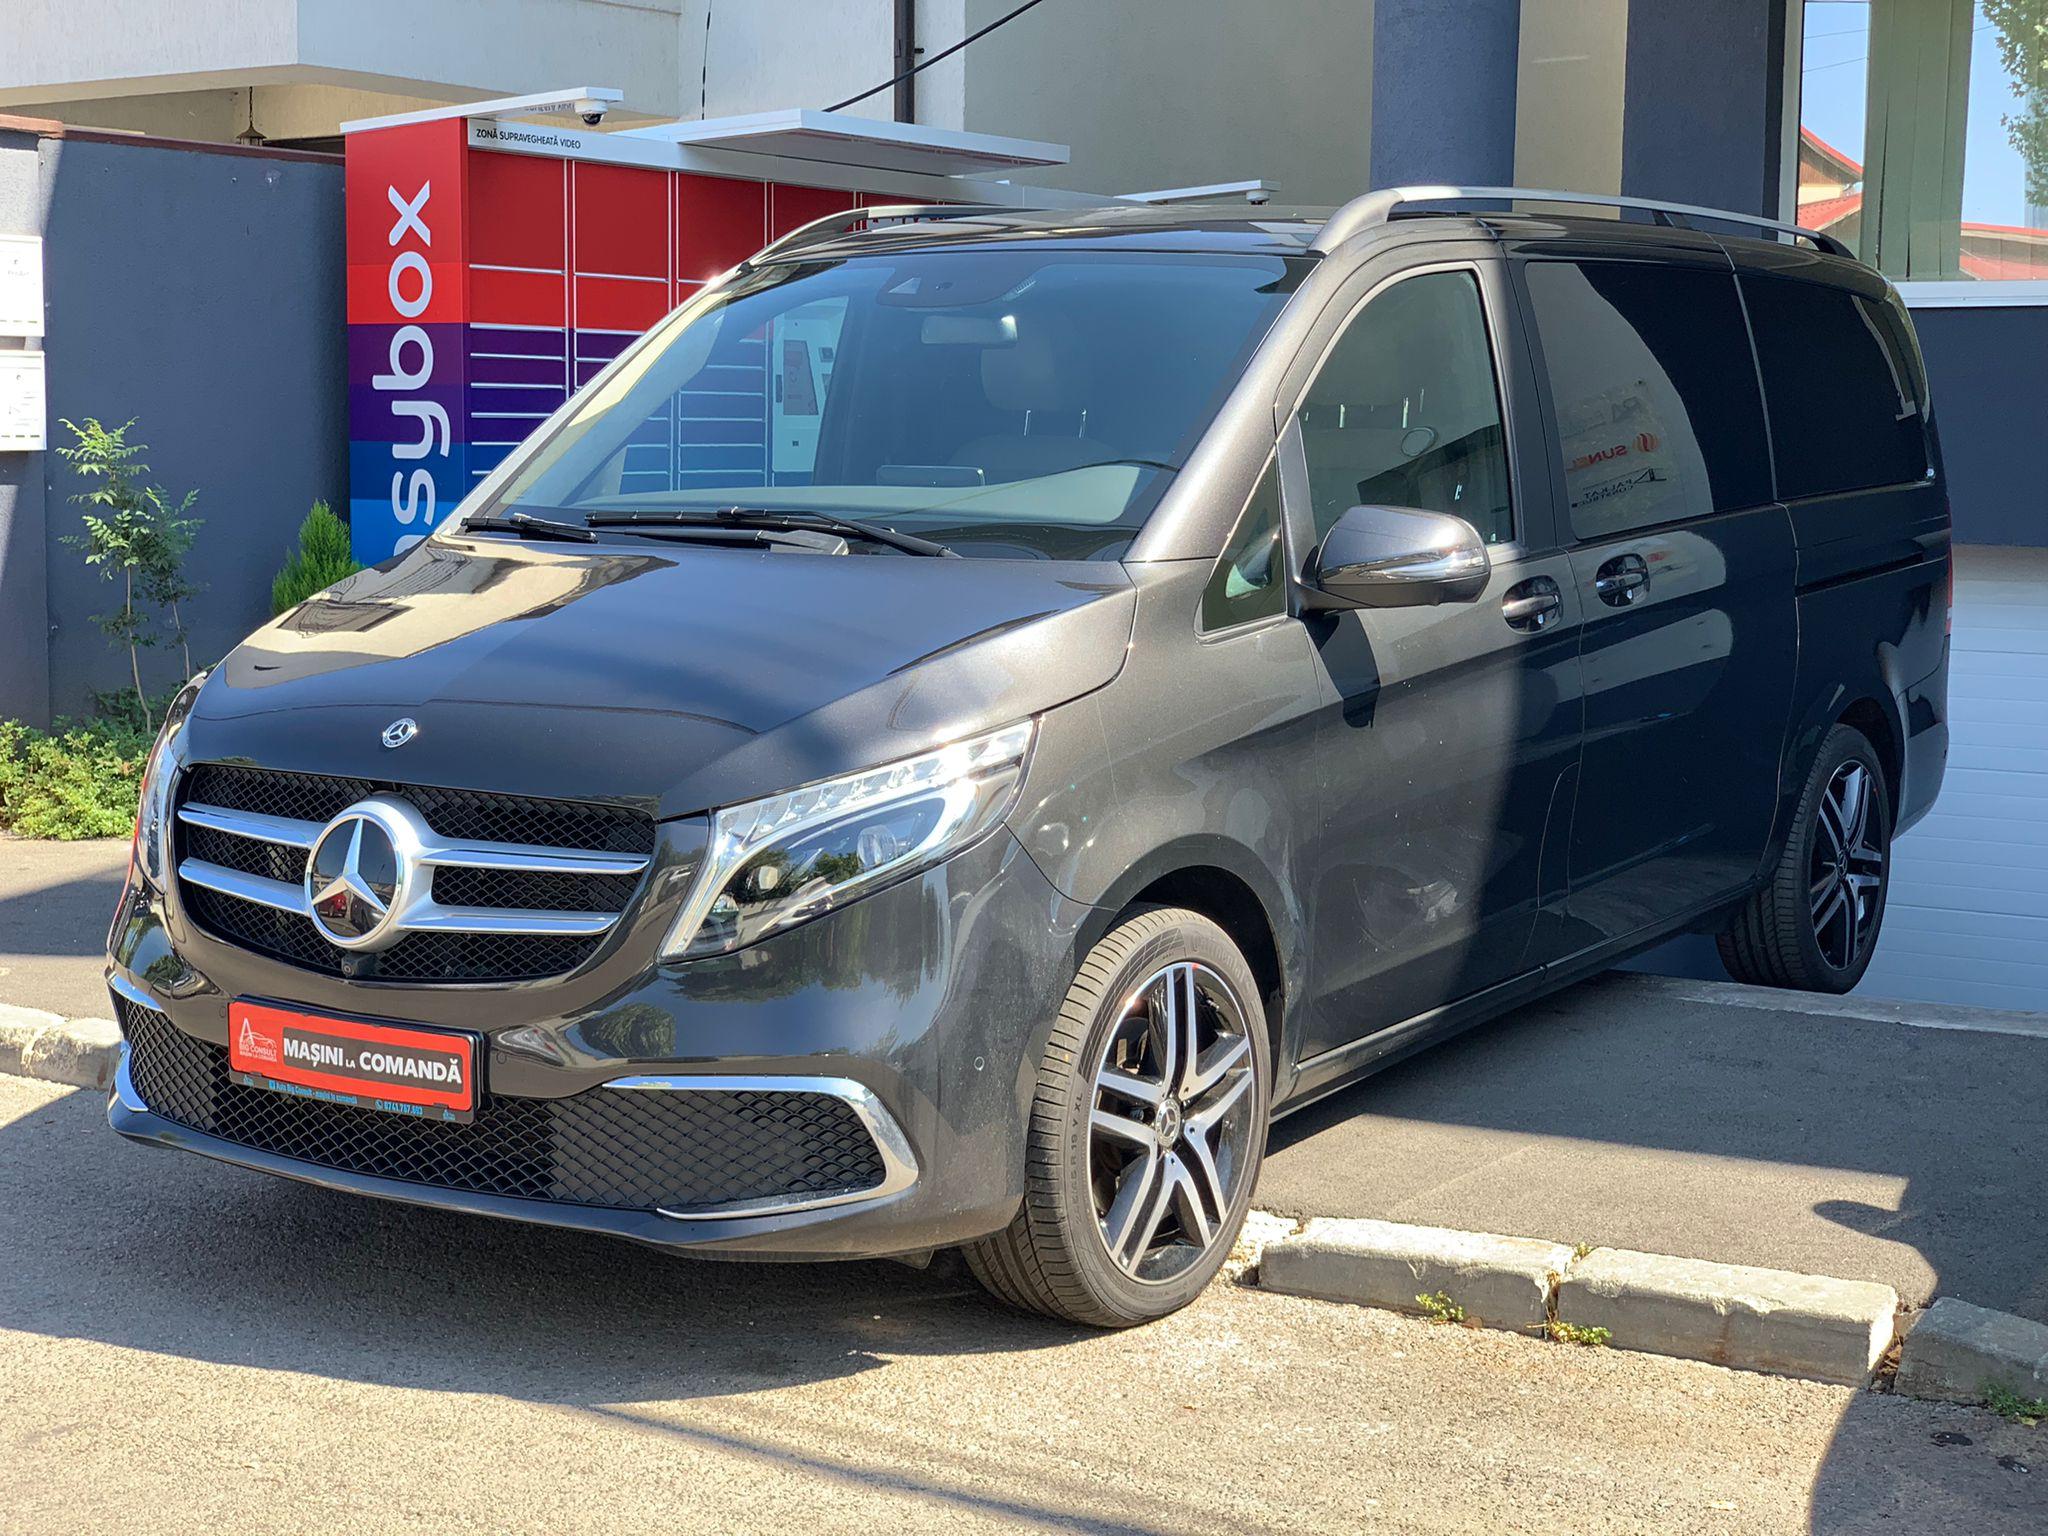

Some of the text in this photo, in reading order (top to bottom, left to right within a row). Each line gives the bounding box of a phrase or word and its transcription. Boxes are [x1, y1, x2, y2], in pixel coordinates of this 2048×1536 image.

[476, 129, 581, 149] ZONĂ SUPRAVEGHEATĂ VIDEO
[250, 1045, 277, 1057] CONSULT
[283, 1038, 343, 1067] MAȘINI
[345, 1059, 355, 1069] LA
[359, 1051, 462, 1084] COMANDĂ
